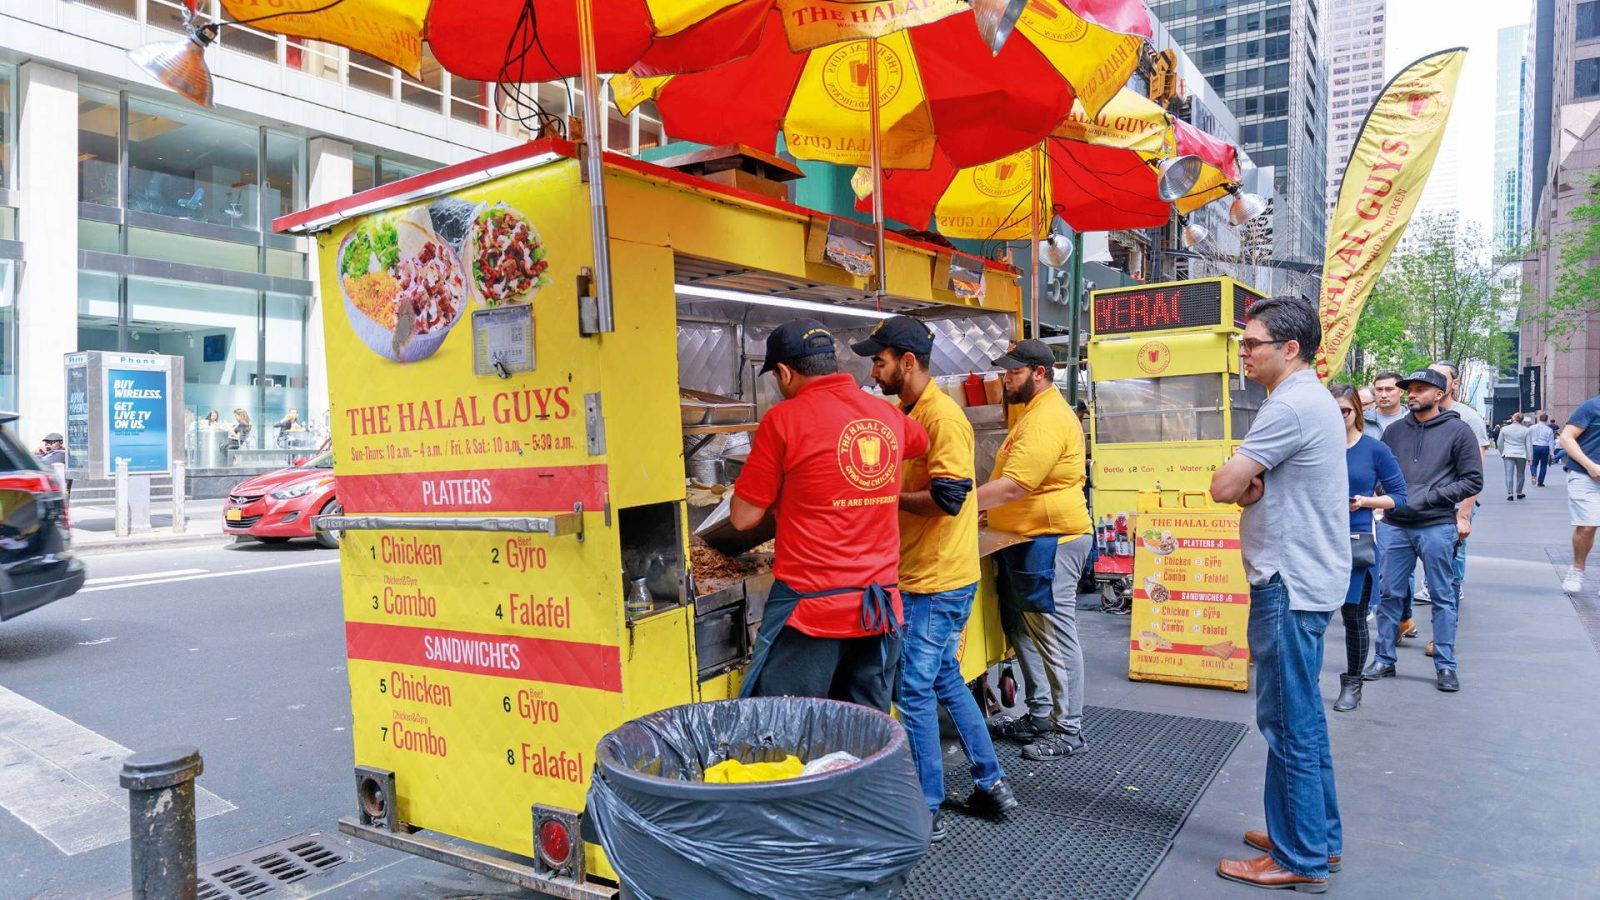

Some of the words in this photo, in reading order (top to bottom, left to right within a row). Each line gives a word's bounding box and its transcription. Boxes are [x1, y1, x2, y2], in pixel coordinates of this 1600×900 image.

[792, 6, 845, 27] THE
[1355, 138, 1410, 221] GUYS
[120, 356, 156, 365] Phone
[113, 379, 135, 389] BUY
[114, 389, 162, 399] WIRELESS.
[114, 402, 134, 411] GET
[346, 404, 392, 436] THE
[397, 395, 486, 433] HALAL
[492, 386, 570, 424] GUYS
[114, 411, 135, 420] LIVE
[138, 411, 151, 420] TV
[114, 420, 130, 430] ON
[130, 420, 145, 430] US.
[427, 445, 442, 457] a.m.
[450, 440, 463, 456] Fri.
[466, 439, 471, 455] &
[492, 436, 502, 453] 10
[532, 433, 551, 451] 5:30
[555, 436, 574, 450] a.m.
[841, 434, 852, 454] THE
[848, 422, 879, 436] HALAL
[880, 426, 898, 451] GUYS
[859, 479, 871, 487] and
[870, 463, 896, 487] CHICKEN
[1179, 464, 1202, 472] Water
[422, 478, 492, 506] PLATTERS
[832, 499, 847, 507] WE
[847, 498, 863, 507] ARE
[1151, 518, 1171, 527] THE
[1174, 518, 1209, 527] HALAL
[1211, 519, 1239, 528] GUYS
[517, 536, 532, 546] Beef
[1183, 539, 1215, 547] PLATTERS
[370, 546, 376, 560] 1
[381, 535, 442, 566] Chicken
[491, 548, 500, 563] 2
[506, 538, 547, 573] Gyro
[1164, 556, 1191, 566] Chicken
[372, 596, 379, 610] 3
[384, 586, 437, 618] Combo
[1181, 592, 1223, 602] SANDWICHES
[495, 604, 503, 619] 4
[510, 593, 570, 629] Falafel
[1162, 606, 1190, 616] Chicken
[424, 635, 520, 670] SANDWICHES
[380, 679, 387, 693] 5
[391, 670, 452, 707] Chicken
[529, 687, 544, 699] Beef
[503, 697, 511, 712] 6
[518, 689, 559, 724] Gyro
[381, 728, 388, 742] 7
[392, 721, 447, 757] Combo
[507, 749, 515, 765] 8
[521, 743, 584, 784] Falafel
